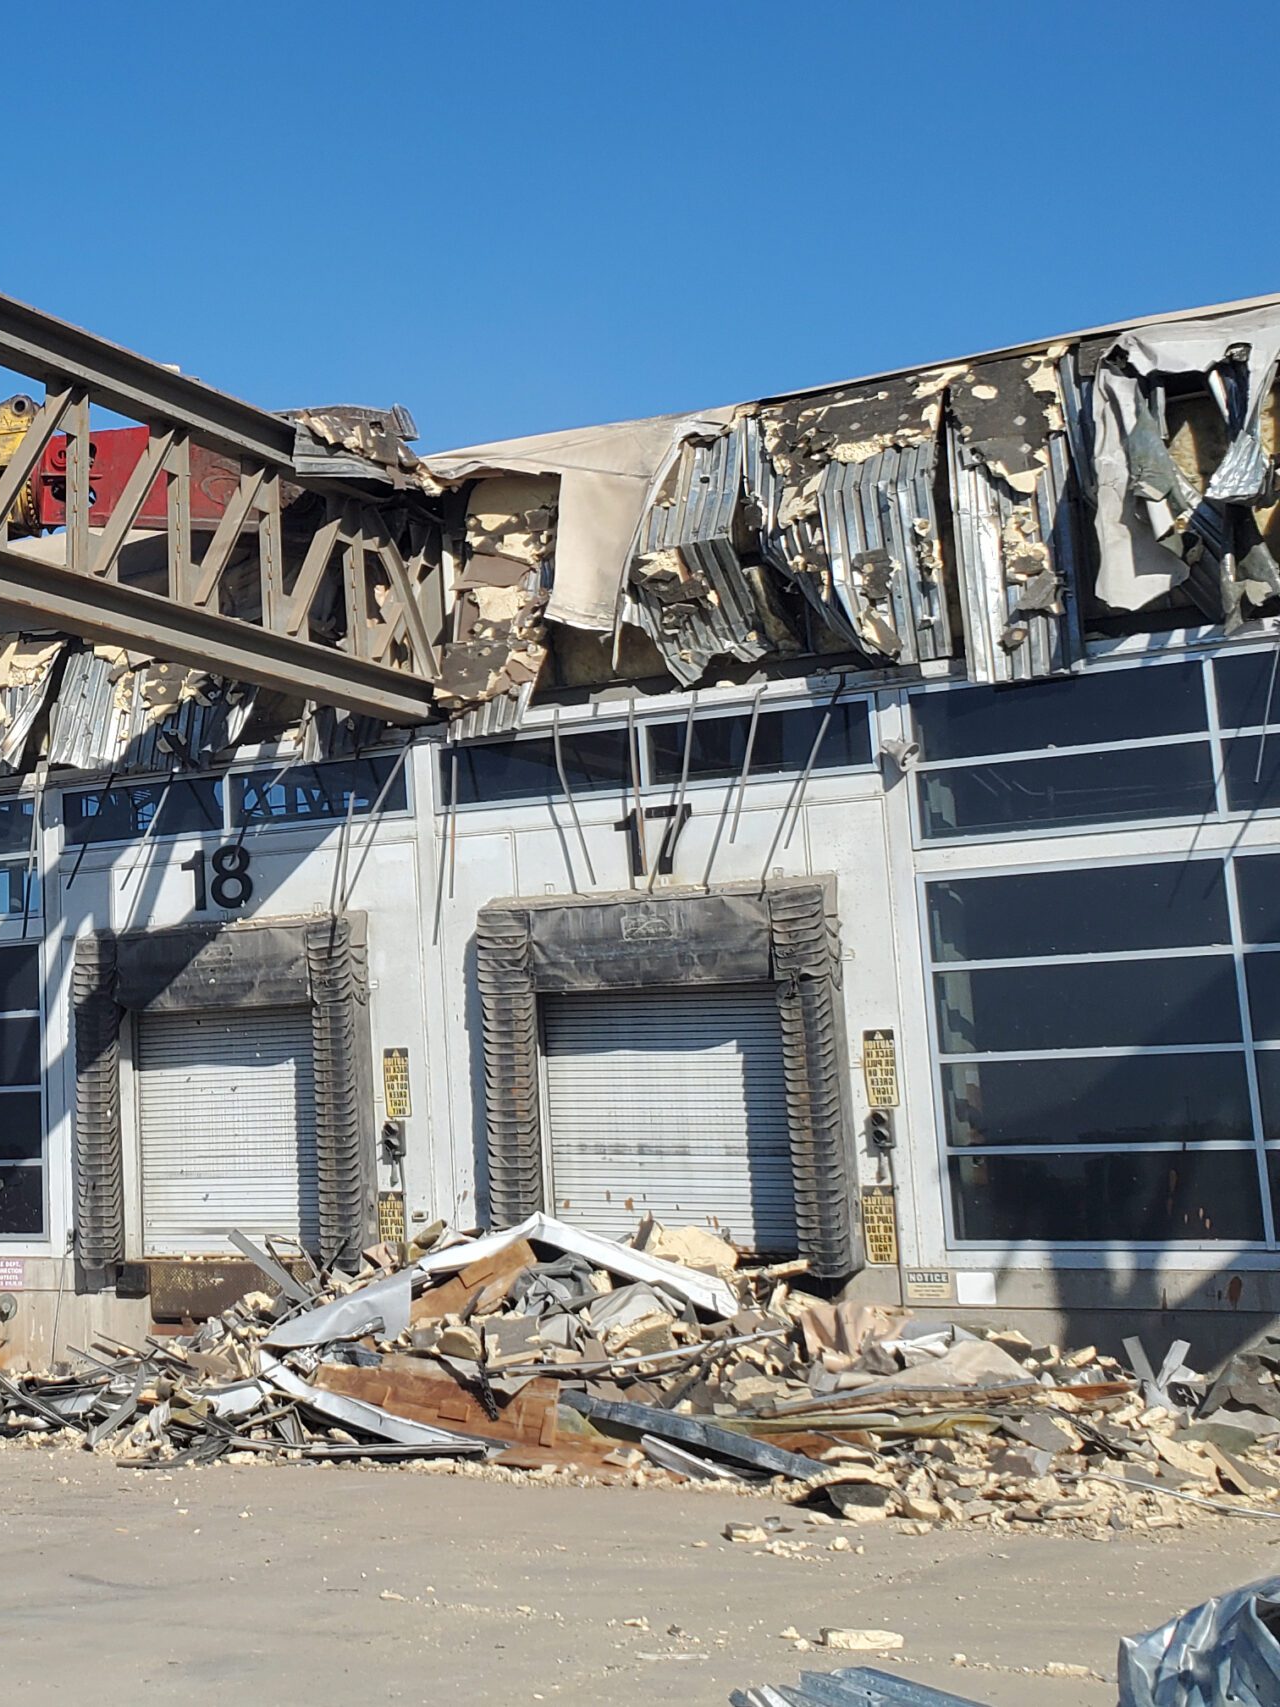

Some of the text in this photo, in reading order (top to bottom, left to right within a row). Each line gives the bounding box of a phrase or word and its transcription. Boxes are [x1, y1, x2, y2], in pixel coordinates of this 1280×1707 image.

[614, 803, 692, 876] 17
[181, 844, 253, 911] 18
[865, 1207, 884, 1215] BACK
[876, 1216, 893, 1224] PULL
[867, 1225, 881, 1233] OUT
[869, 1235, 893, 1243] GREEN
[870, 1244, 893, 1252] LIGHT
[874, 1254, 891, 1262] ONLY
[908, 1273, 948, 1282] NOTICE
